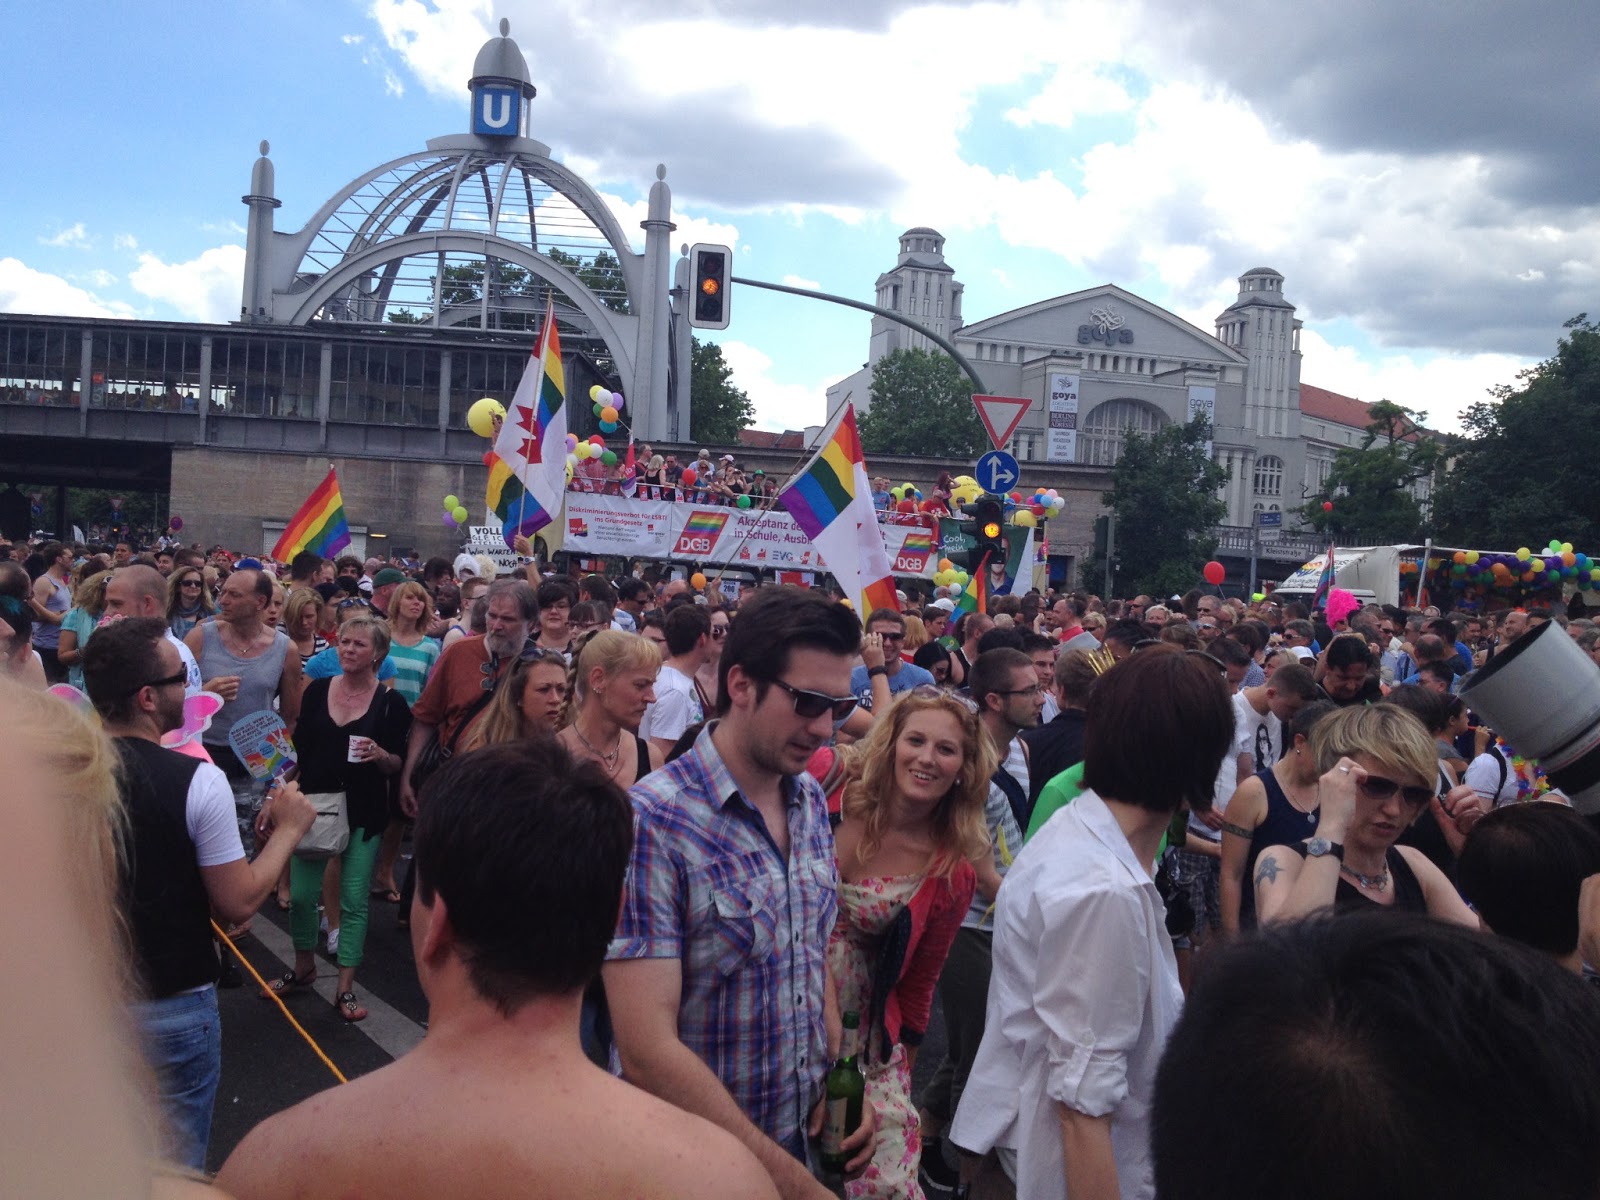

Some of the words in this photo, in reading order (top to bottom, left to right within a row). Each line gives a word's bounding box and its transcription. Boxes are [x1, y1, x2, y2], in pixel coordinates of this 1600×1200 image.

[483, 94, 510, 129] U
[1052, 391, 1077, 401] goya
[1190, 399, 1214, 409] goya
[569, 506, 640, 519] Diskriminierungsverbot
[604, 518, 643, 527] Grundgesetz
[738, 516, 788, 530] Akzeptanz
[791, 522, 802, 531] de
[734, 528, 744, 538] in
[748, 530, 780, 543] Schule,
[943, 532, 966, 544] Cool,
[680, 536, 710, 551] DGB
[1266, 548, 1302, 557] Kleiststraße
[897, 556, 922, 571] DGB
